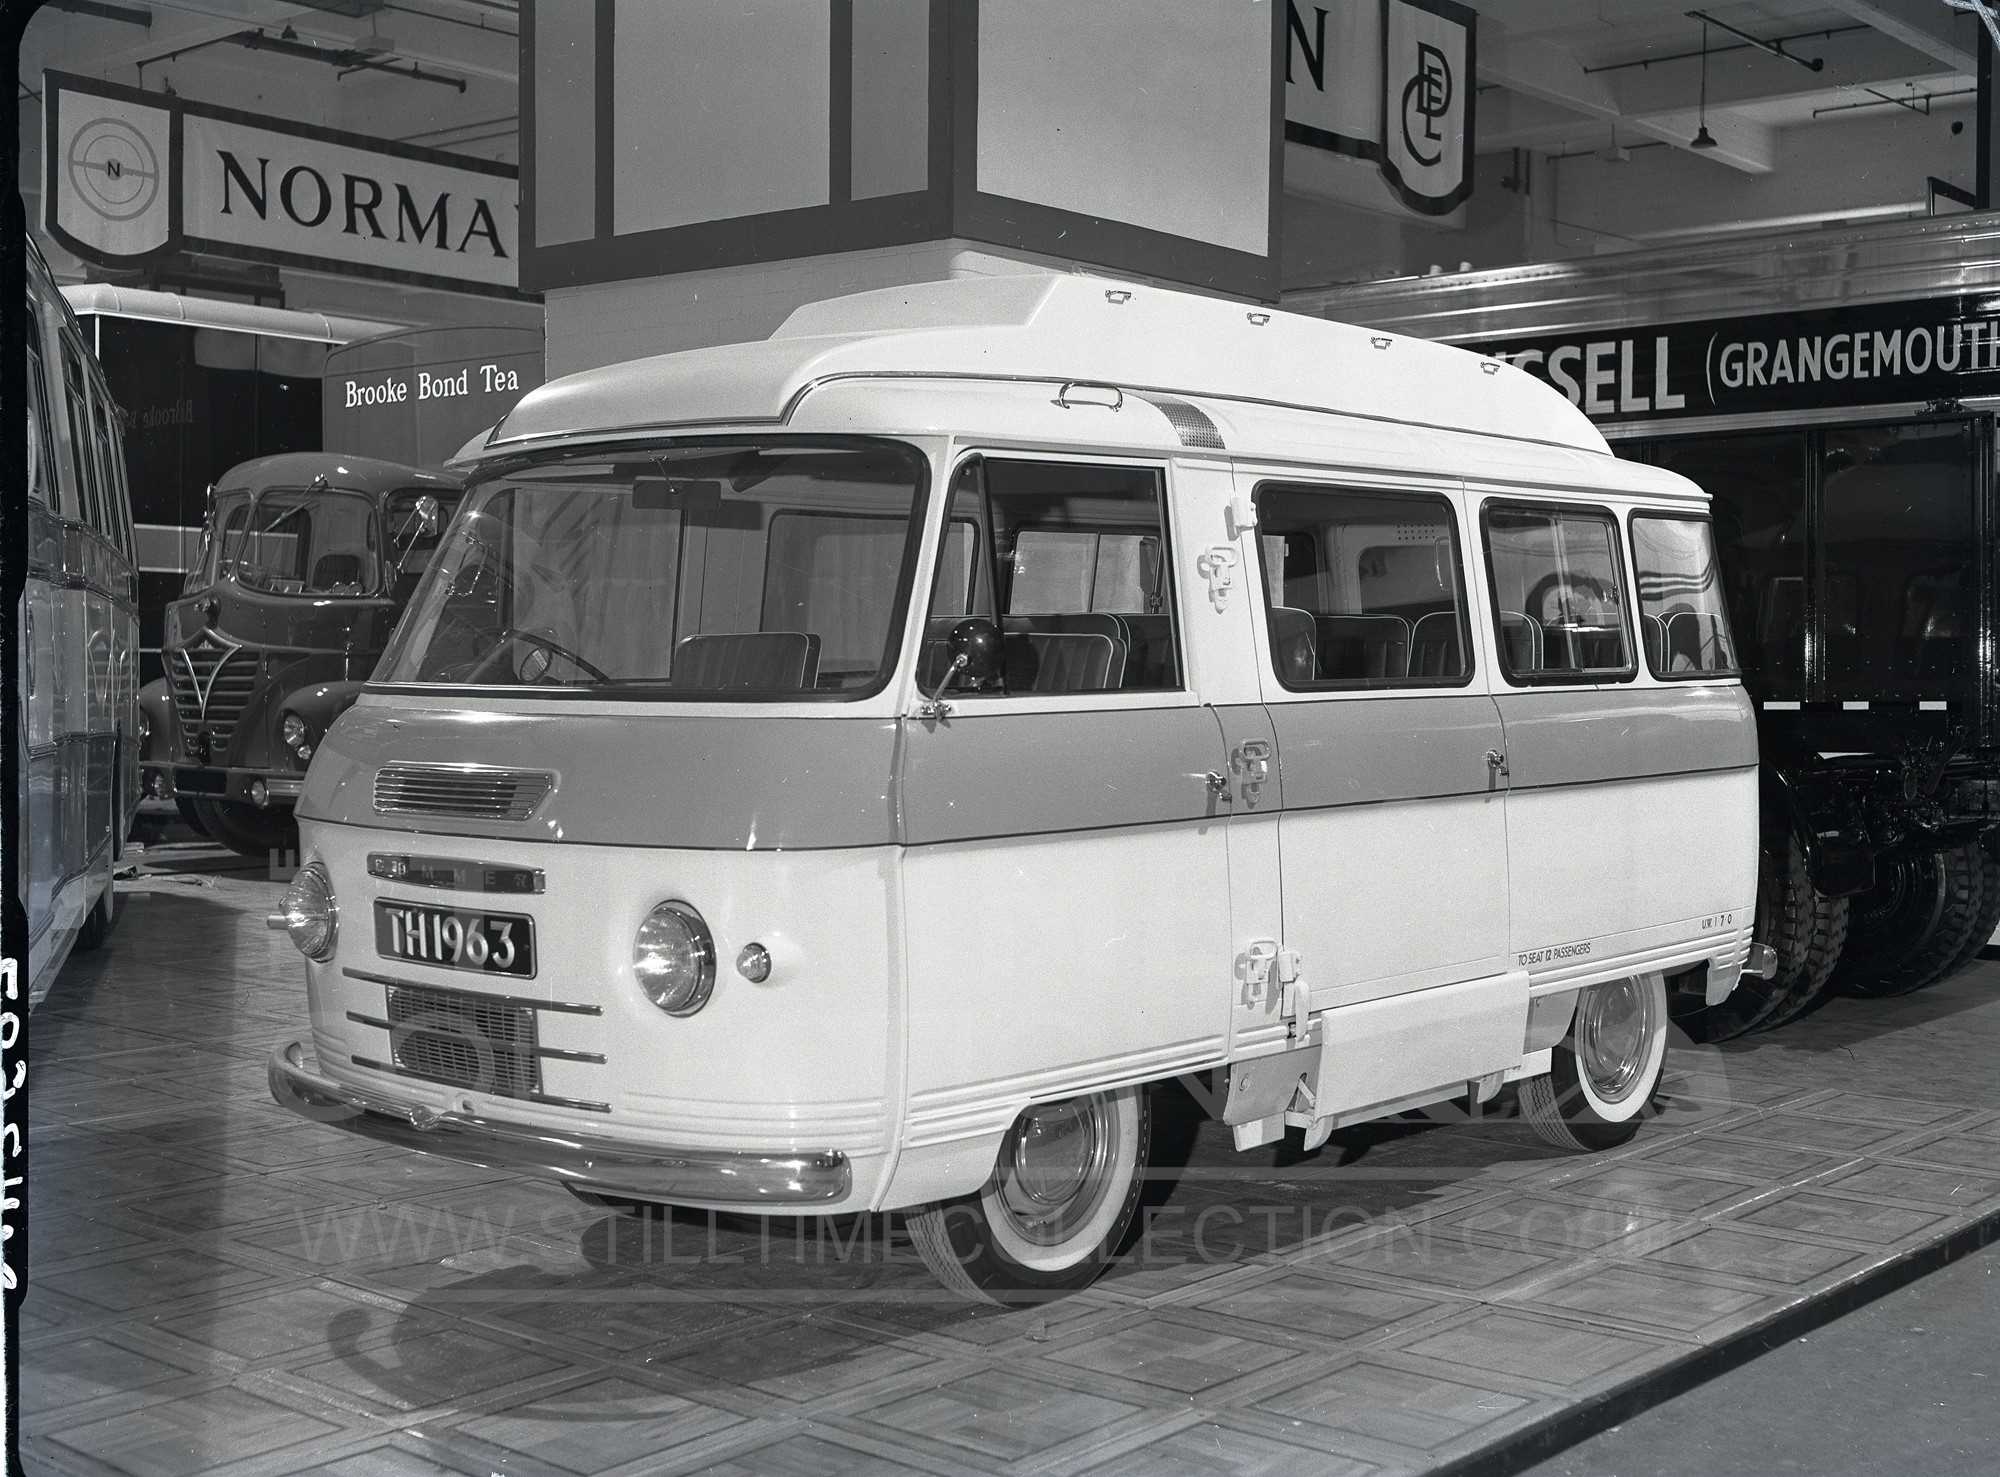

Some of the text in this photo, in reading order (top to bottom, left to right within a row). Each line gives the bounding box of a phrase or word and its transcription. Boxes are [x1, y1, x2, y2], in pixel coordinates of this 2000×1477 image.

[106, 160, 121, 179] N
[216, 149, 519, 258] NORMA
[345, 364, 519, 408] Brooke Bond Tea
[1495, 337, 1685, 415] SELL
[1518, 942, 1591, 967] TO SEAT 12 PASSENGERS
